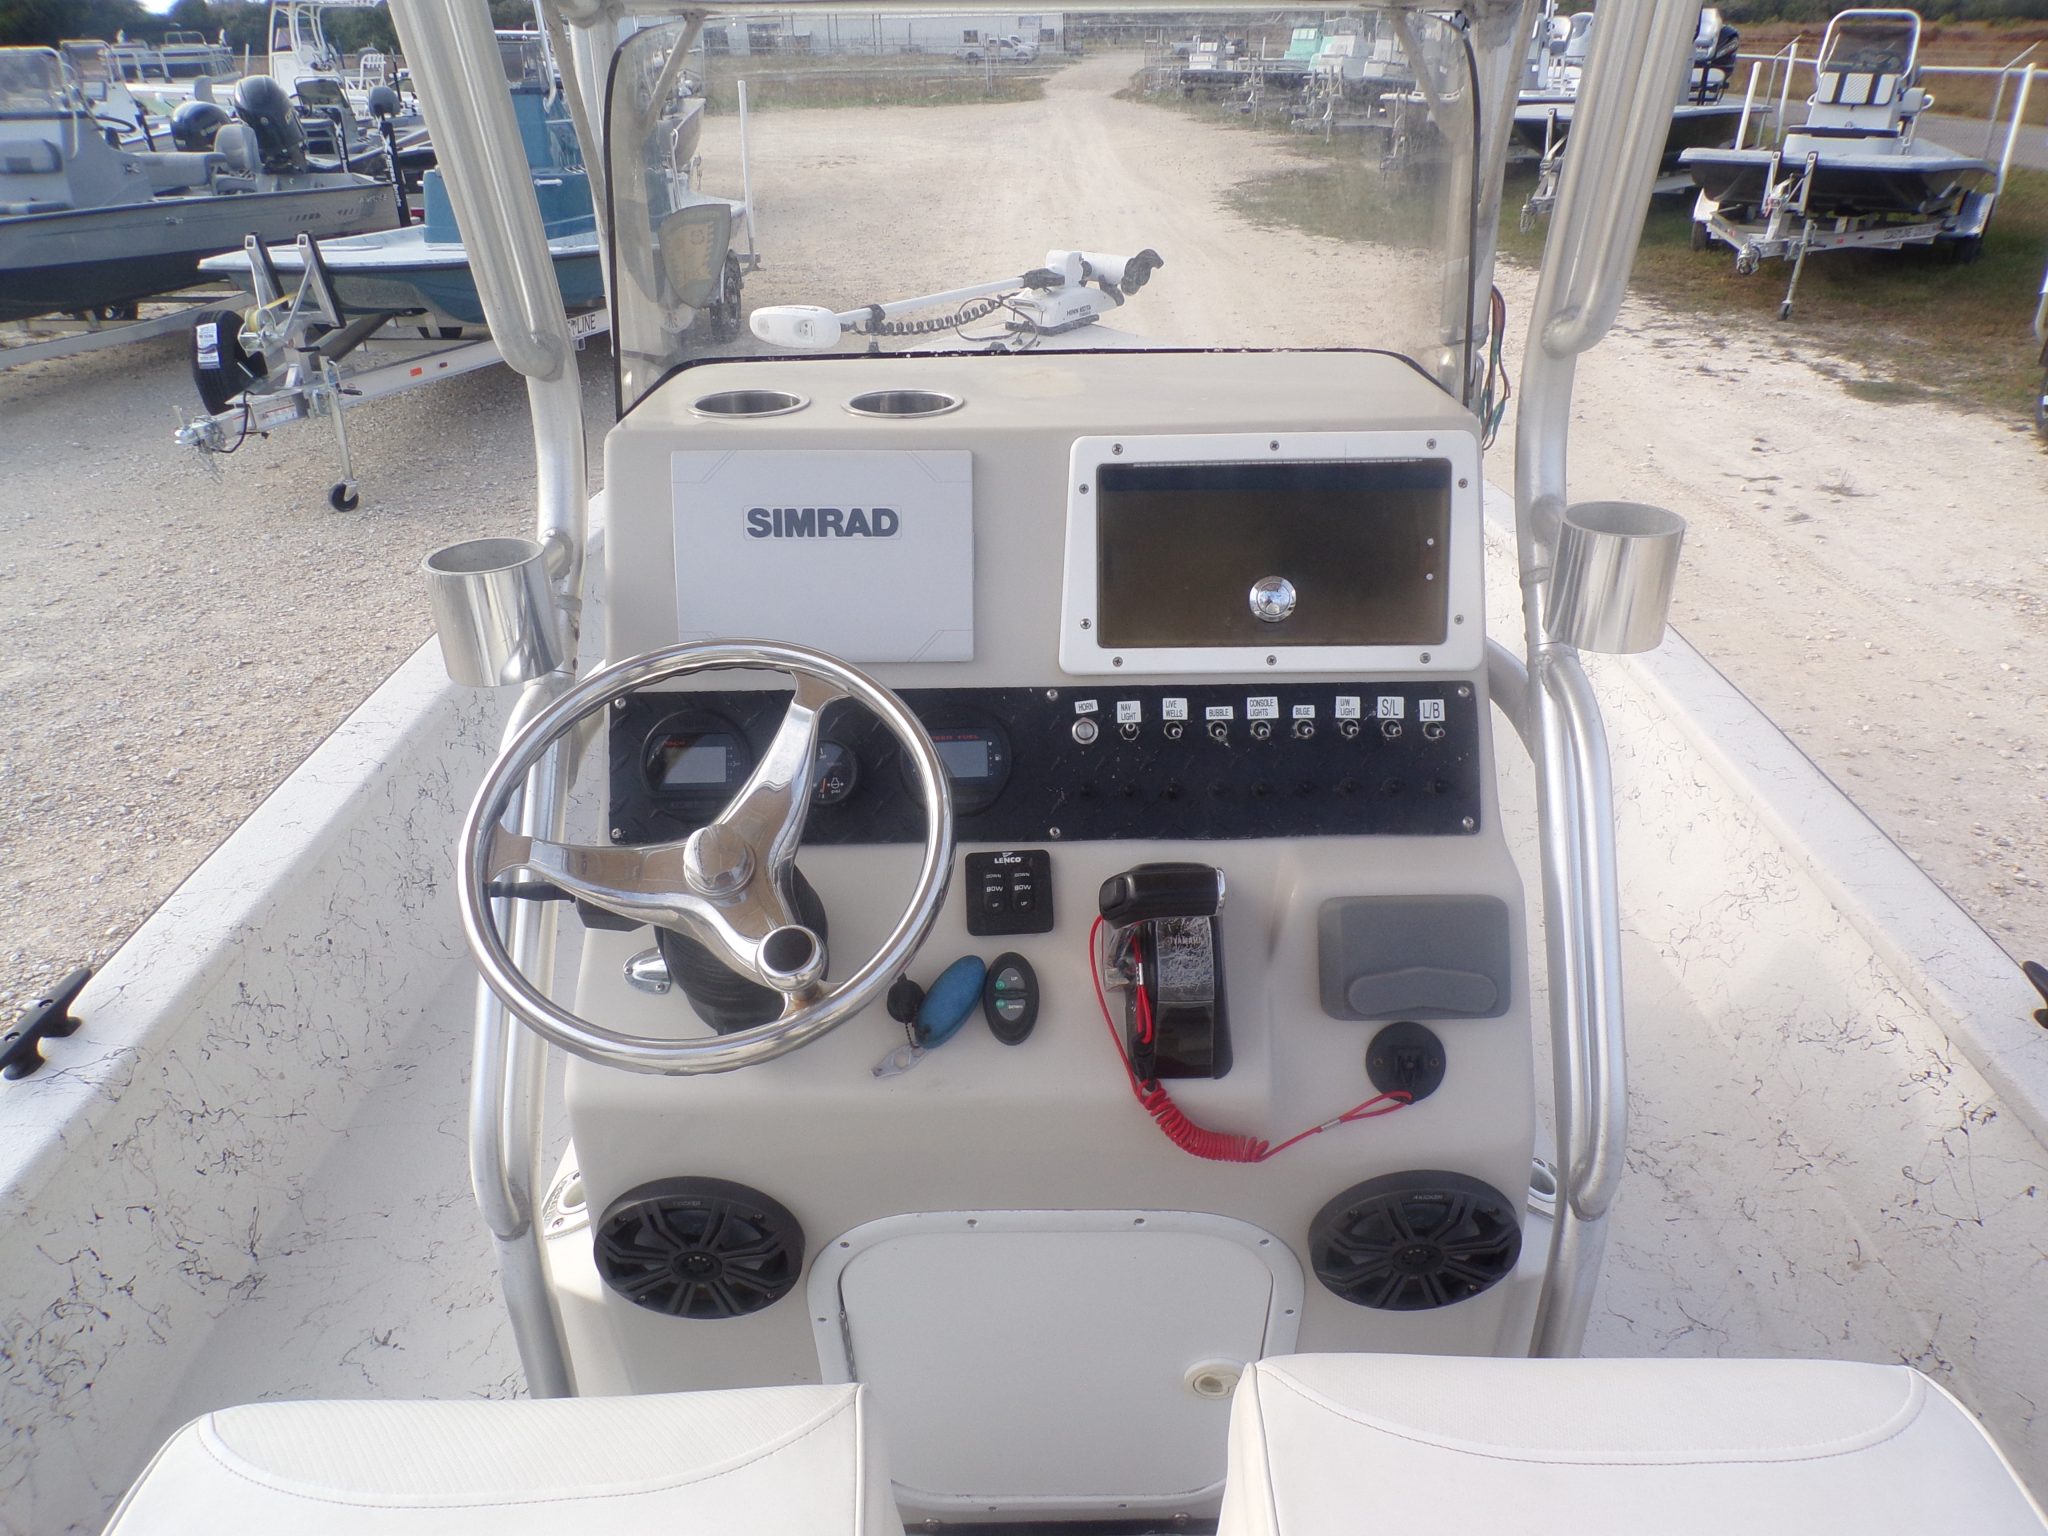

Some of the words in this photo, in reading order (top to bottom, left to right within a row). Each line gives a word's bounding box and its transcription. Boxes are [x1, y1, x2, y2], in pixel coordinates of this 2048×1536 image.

[746, 507, 899, 538] SIMRAD
[1078, 702, 1094, 712] HORN
[1165, 700, 1177, 708] LIVE
[1249, 699, 1274, 707] CONSOLE
[1295, 707, 1311, 715] BILGE
[1381, 699, 1399, 716] S/L
[1422, 702, 1440, 719] L/B
[1120, 712, 1137, 720] LIGHT
[1165, 710, 1183, 718] WELLS
[1208, 709, 1229, 717] BUBBLE
[1249, 708, 1269, 716] LIGHTS
[1340, 708, 1356, 716] LIGHT
[986, 885, 1003, 893] BOW
